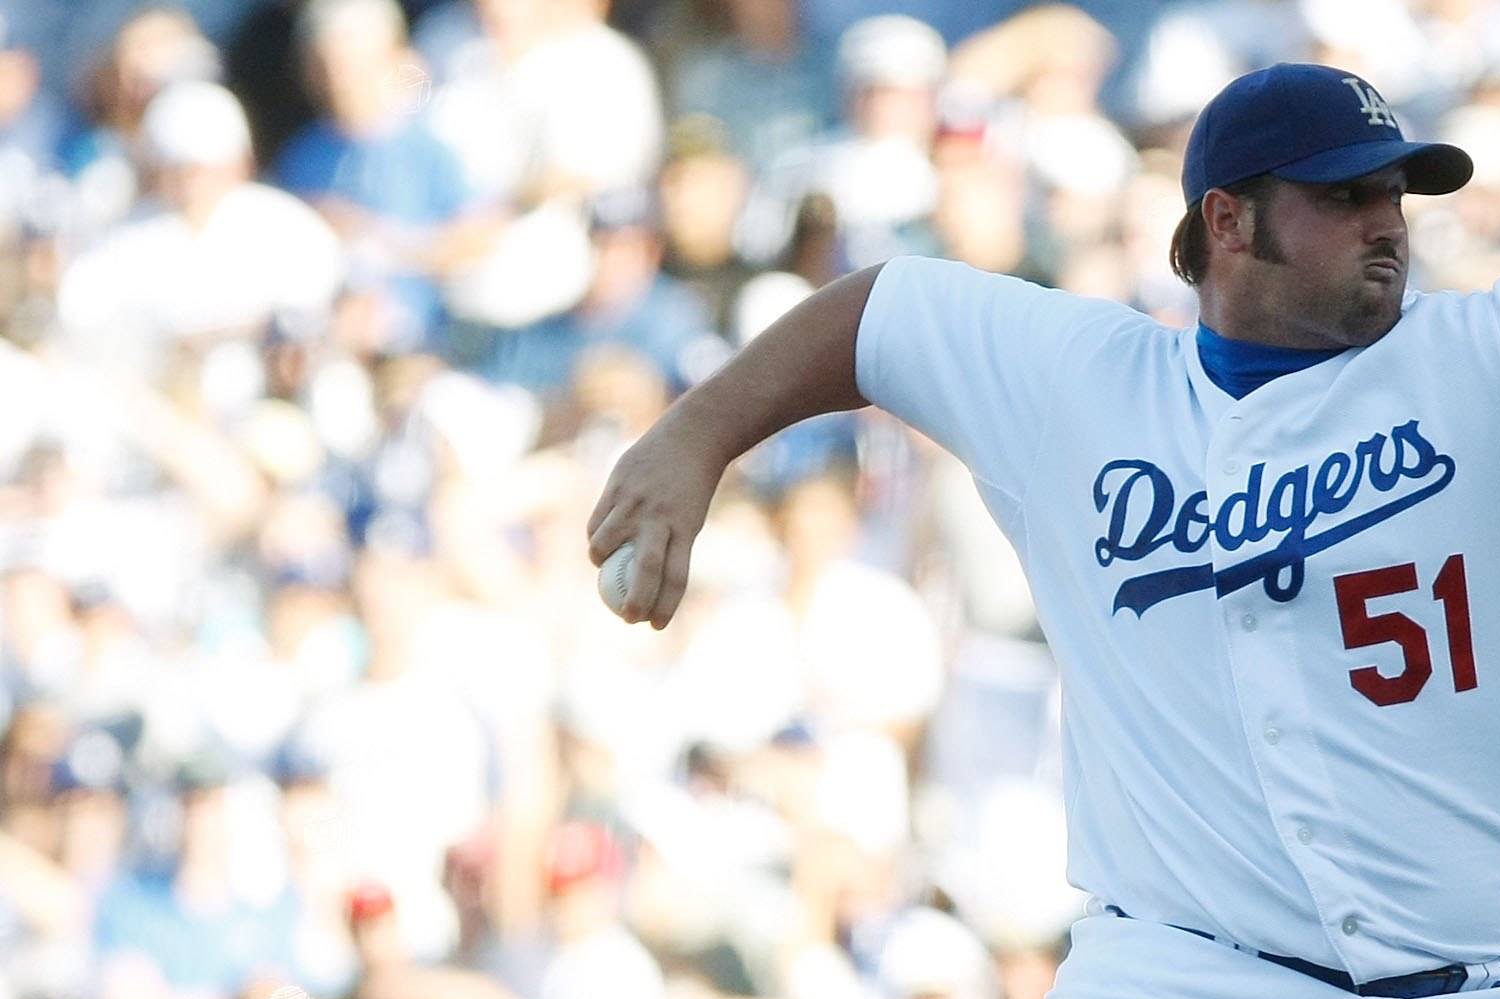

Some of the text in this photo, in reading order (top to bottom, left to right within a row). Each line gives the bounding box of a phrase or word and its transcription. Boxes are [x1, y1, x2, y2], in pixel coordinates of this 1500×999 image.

[1341, 77, 1397, 129] LA
[1093, 419, 1456, 604] Dodgers
[1333, 553, 1478, 707] 51
